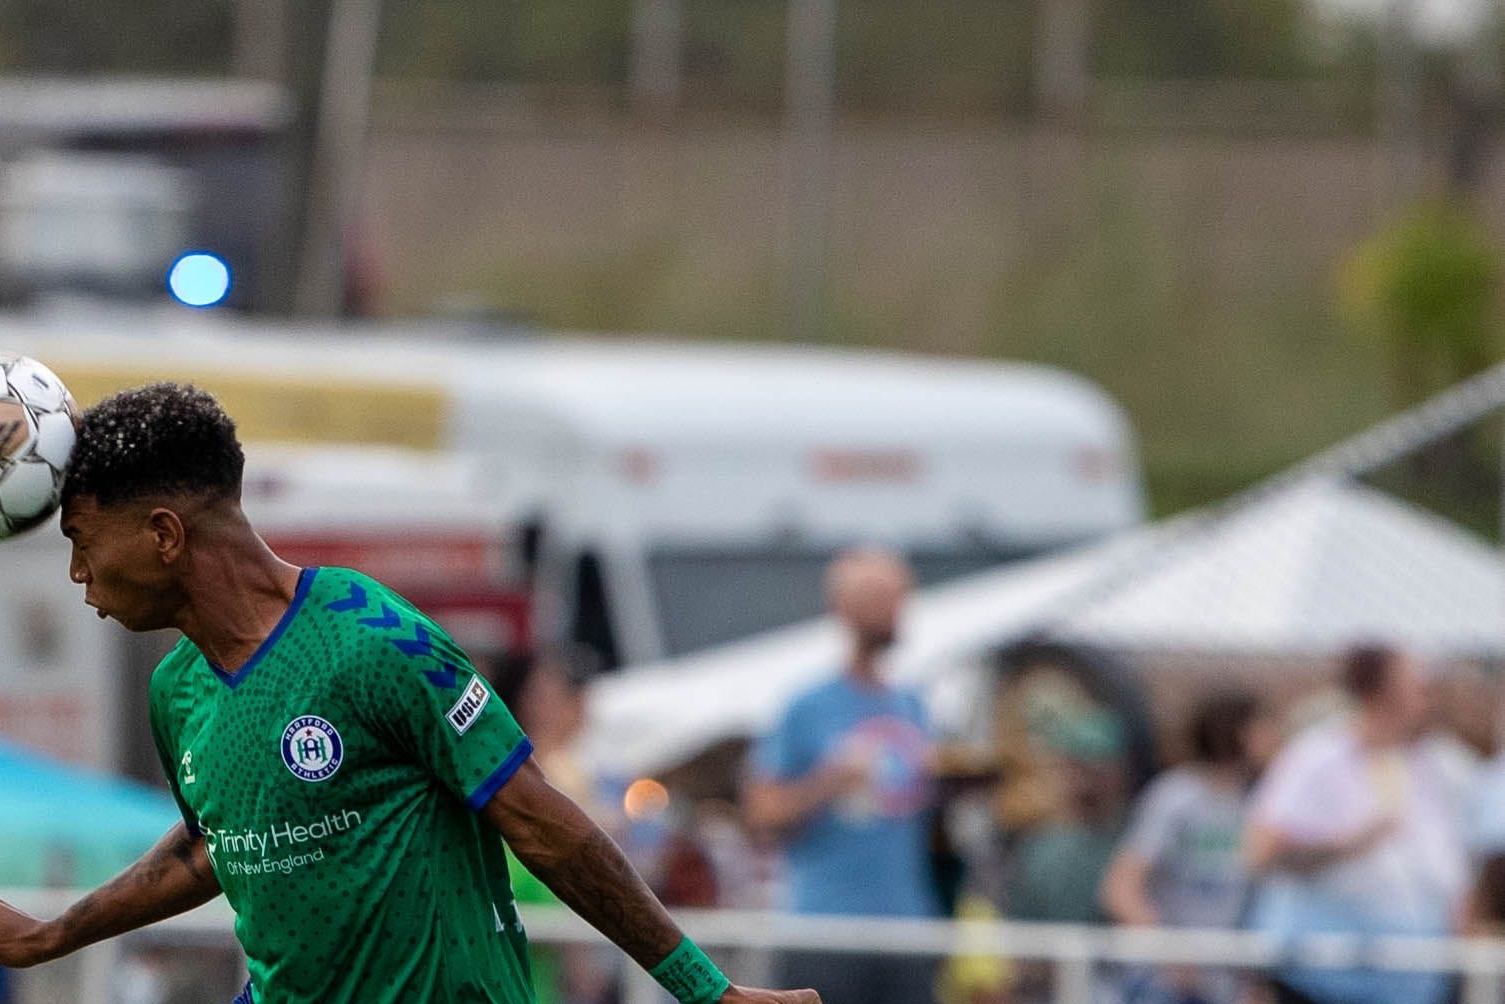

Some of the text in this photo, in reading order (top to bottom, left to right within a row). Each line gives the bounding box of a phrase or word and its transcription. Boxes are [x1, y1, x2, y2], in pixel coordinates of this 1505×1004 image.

[285, 718, 334, 740] HARTFORD
[291, 758, 339, 779] ATHLETIC
[217, 809, 362, 856] Trinity Health
[238, 861, 261, 876] New
[263, 848, 325, 875] England
